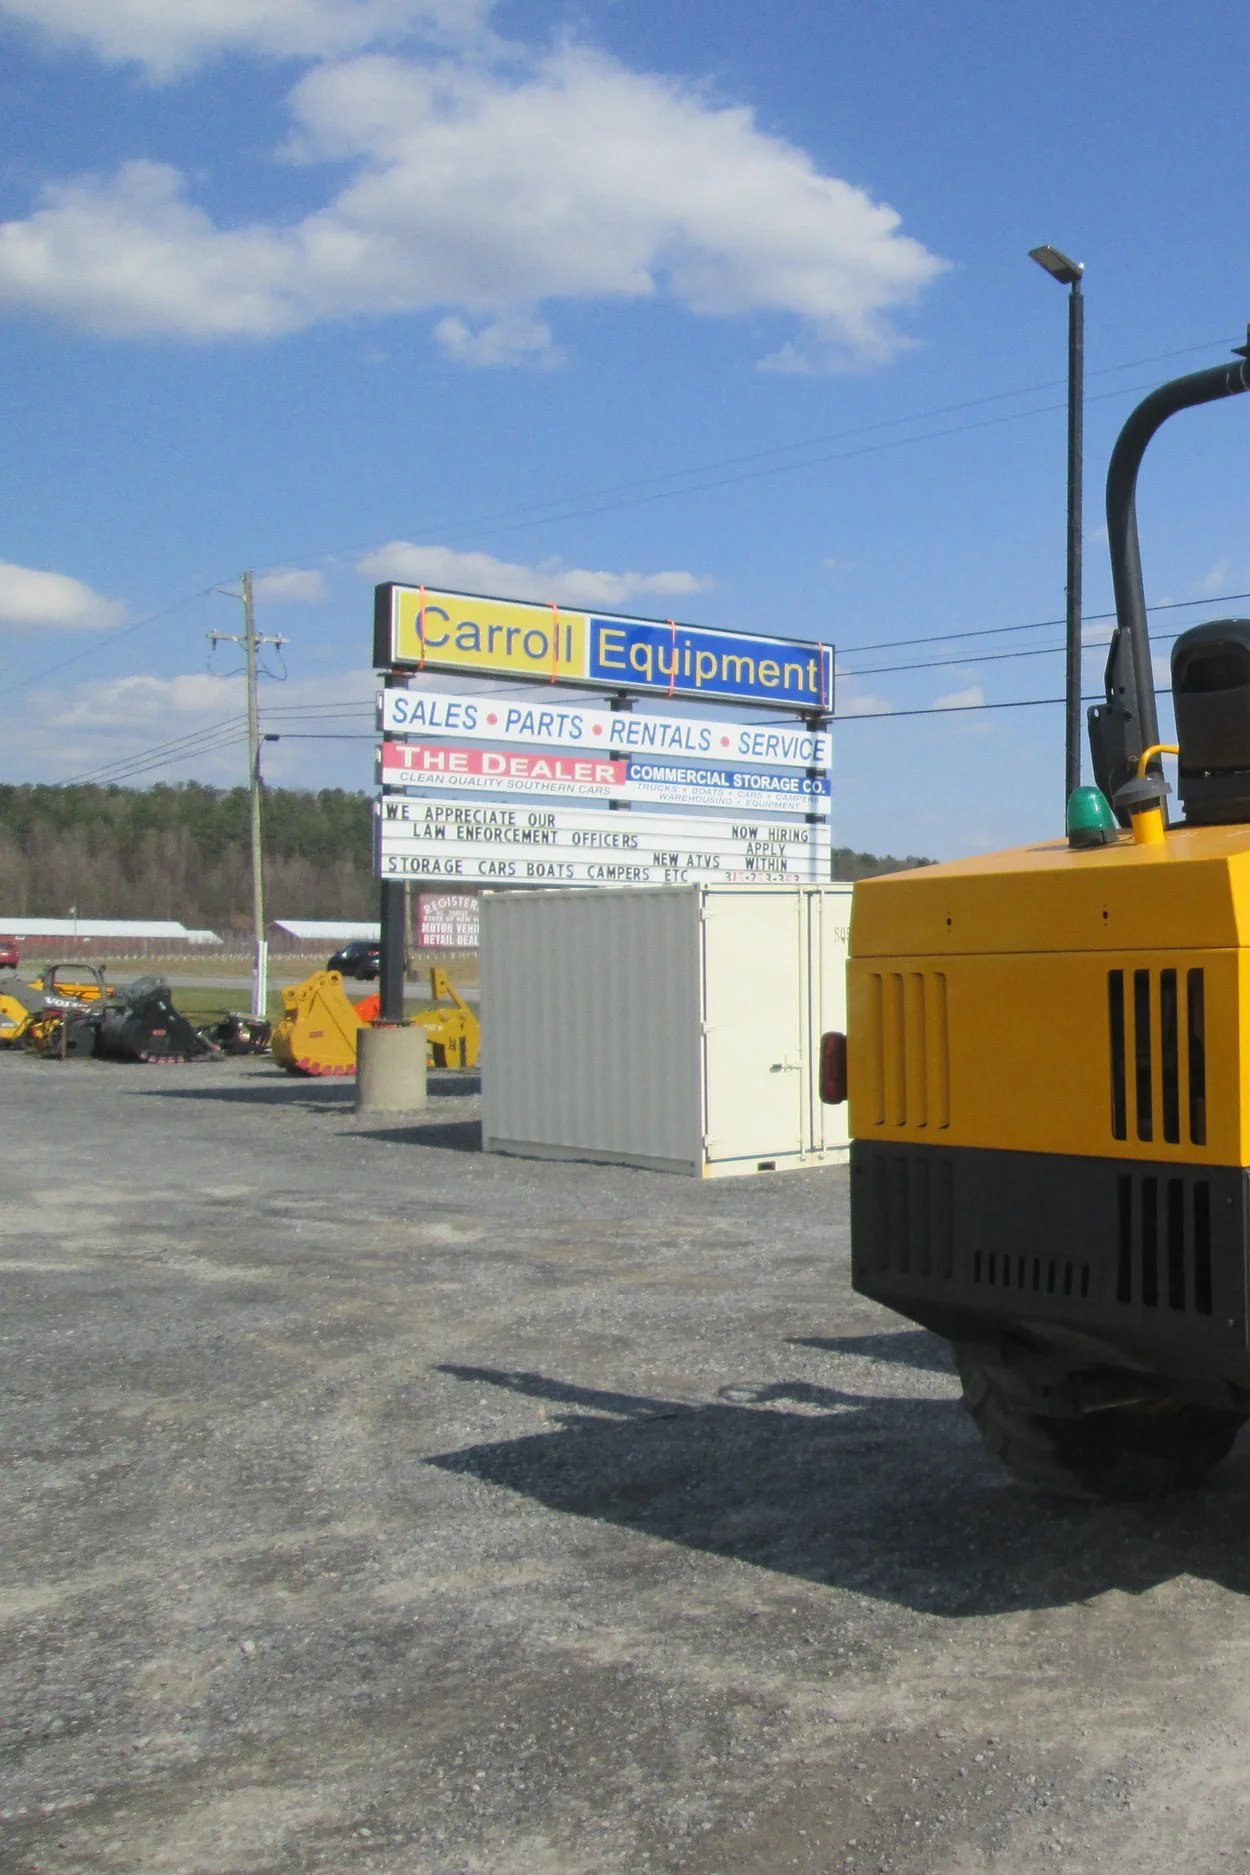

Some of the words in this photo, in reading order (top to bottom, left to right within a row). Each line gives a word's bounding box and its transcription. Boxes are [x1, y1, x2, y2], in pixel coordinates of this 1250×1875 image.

[416, 606, 572, 662] Carroll
[599, 628, 818, 692] Equipment
[392, 698, 478, 730] SALES
[505, 708, 583, 740] PARTS
[609, 719, 712, 751] RENTALS
[738, 731, 826, 761] SERVICE
[396, 745, 468, 772] THE
[482, 753, 616, 783] DEALER
[400, 772, 444, 784] CLEAN
[448, 775, 503, 788] QUALITY
[507, 780, 575, 793] SOUTHERN
[579, 785, 610, 795] CARS
[630, 765, 729, 786] COMMERCIAL
[733, 774, 799, 792] STORAGE
[802, 779, 826, 794] CO.
[636, 783, 678, 793] TRUCKS
[691, 787, 724, 796] BOATS
[737, 790, 762, 799] CARS
[775, 793, 819, 803] CAMPERS
[659, 793, 733, 805] WAREHOUSING
[745, 799, 800, 810] EQUIPMENT
[386, 804, 409, 820] WE
[425, 806, 515, 826] APPRECIATE
[528, 813, 555, 828] OUR
[413, 823, 446, 840] LAW
[457, 825, 558, 844] ENFORCEMENT
[572, 832, 639, 848] OFFICERS
[732, 825, 758, 840] NOW
[768, 828, 808, 843] HIRING
[746, 842, 786, 856] APPLY
[388, 856, 463, 874] STORAGE
[478, 860, 515, 876] CARS
[527, 862, 574, 879] BOATS
[587, 864, 649, 881] CAMPERS
[664, 868, 688, 882] ETC
[653, 852, 679, 867] NEW
[687, 854, 720, 868] ATVS
[745, 857, 787, 872] WITHIN
[424, 896, 479, 914] REGISTER
[422, 922, 453, 933] MOTOR
[424, 934, 454, 945] RETAIL
